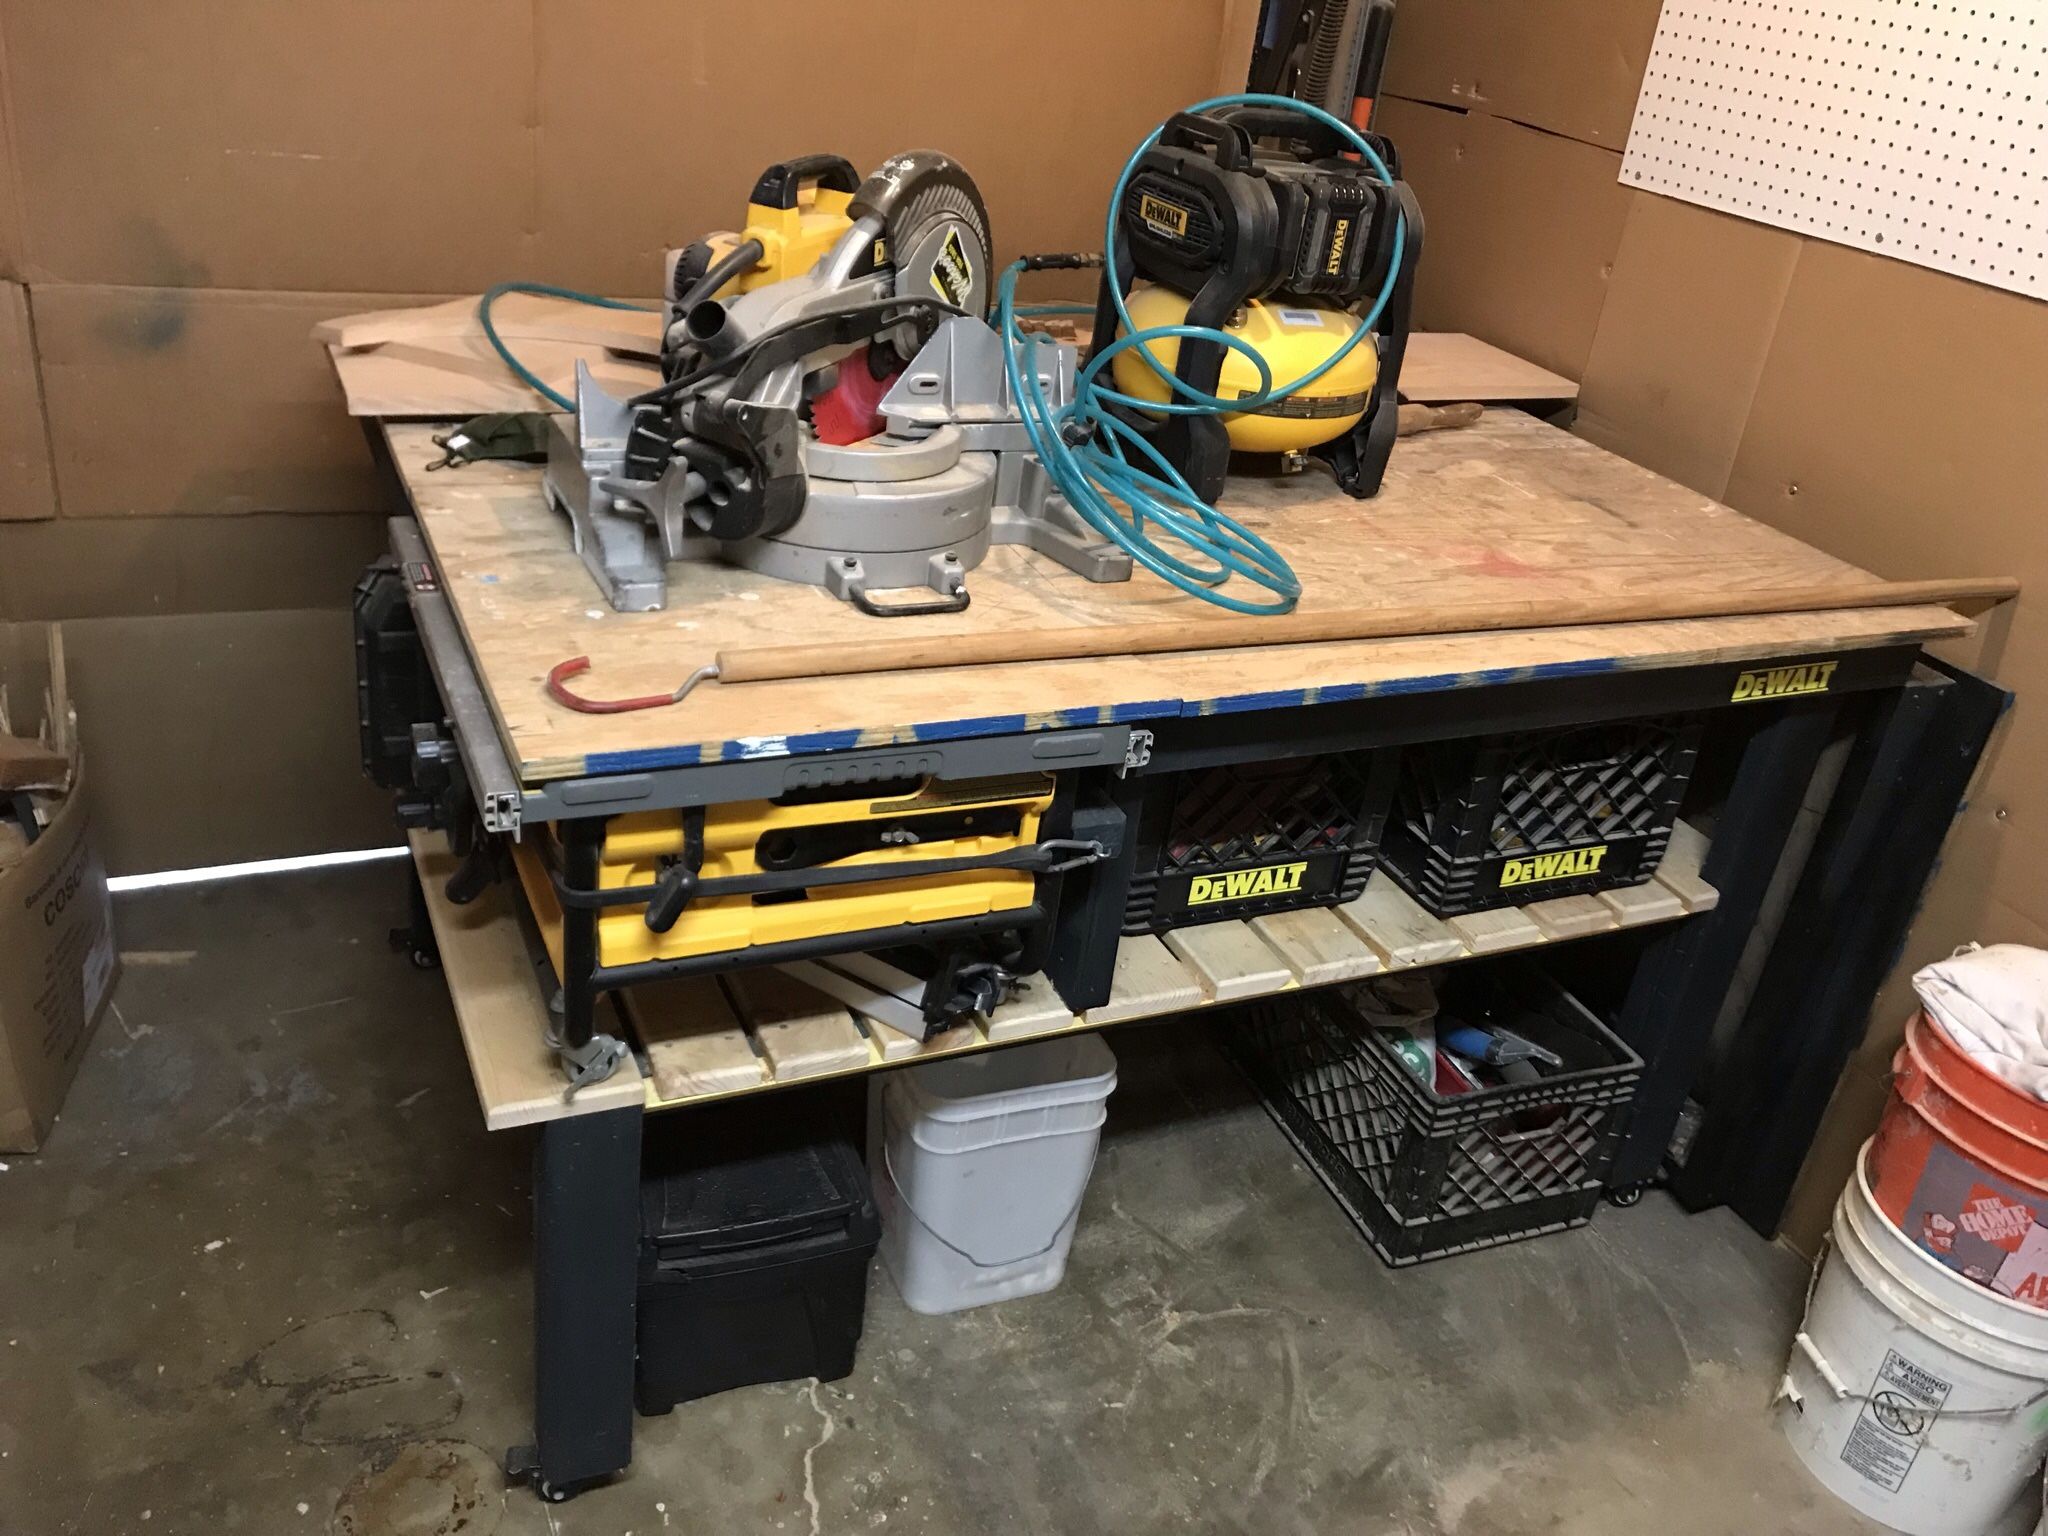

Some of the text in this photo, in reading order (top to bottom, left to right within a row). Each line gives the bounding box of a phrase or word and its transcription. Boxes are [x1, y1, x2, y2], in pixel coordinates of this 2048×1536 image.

[1960, 1205, 2033, 1232] HOME
[1979, 1222, 2027, 1241] DEPOT
[1898, 1358, 1948, 1392] WARNING
[1902, 1373, 1934, 1394] AVISO
